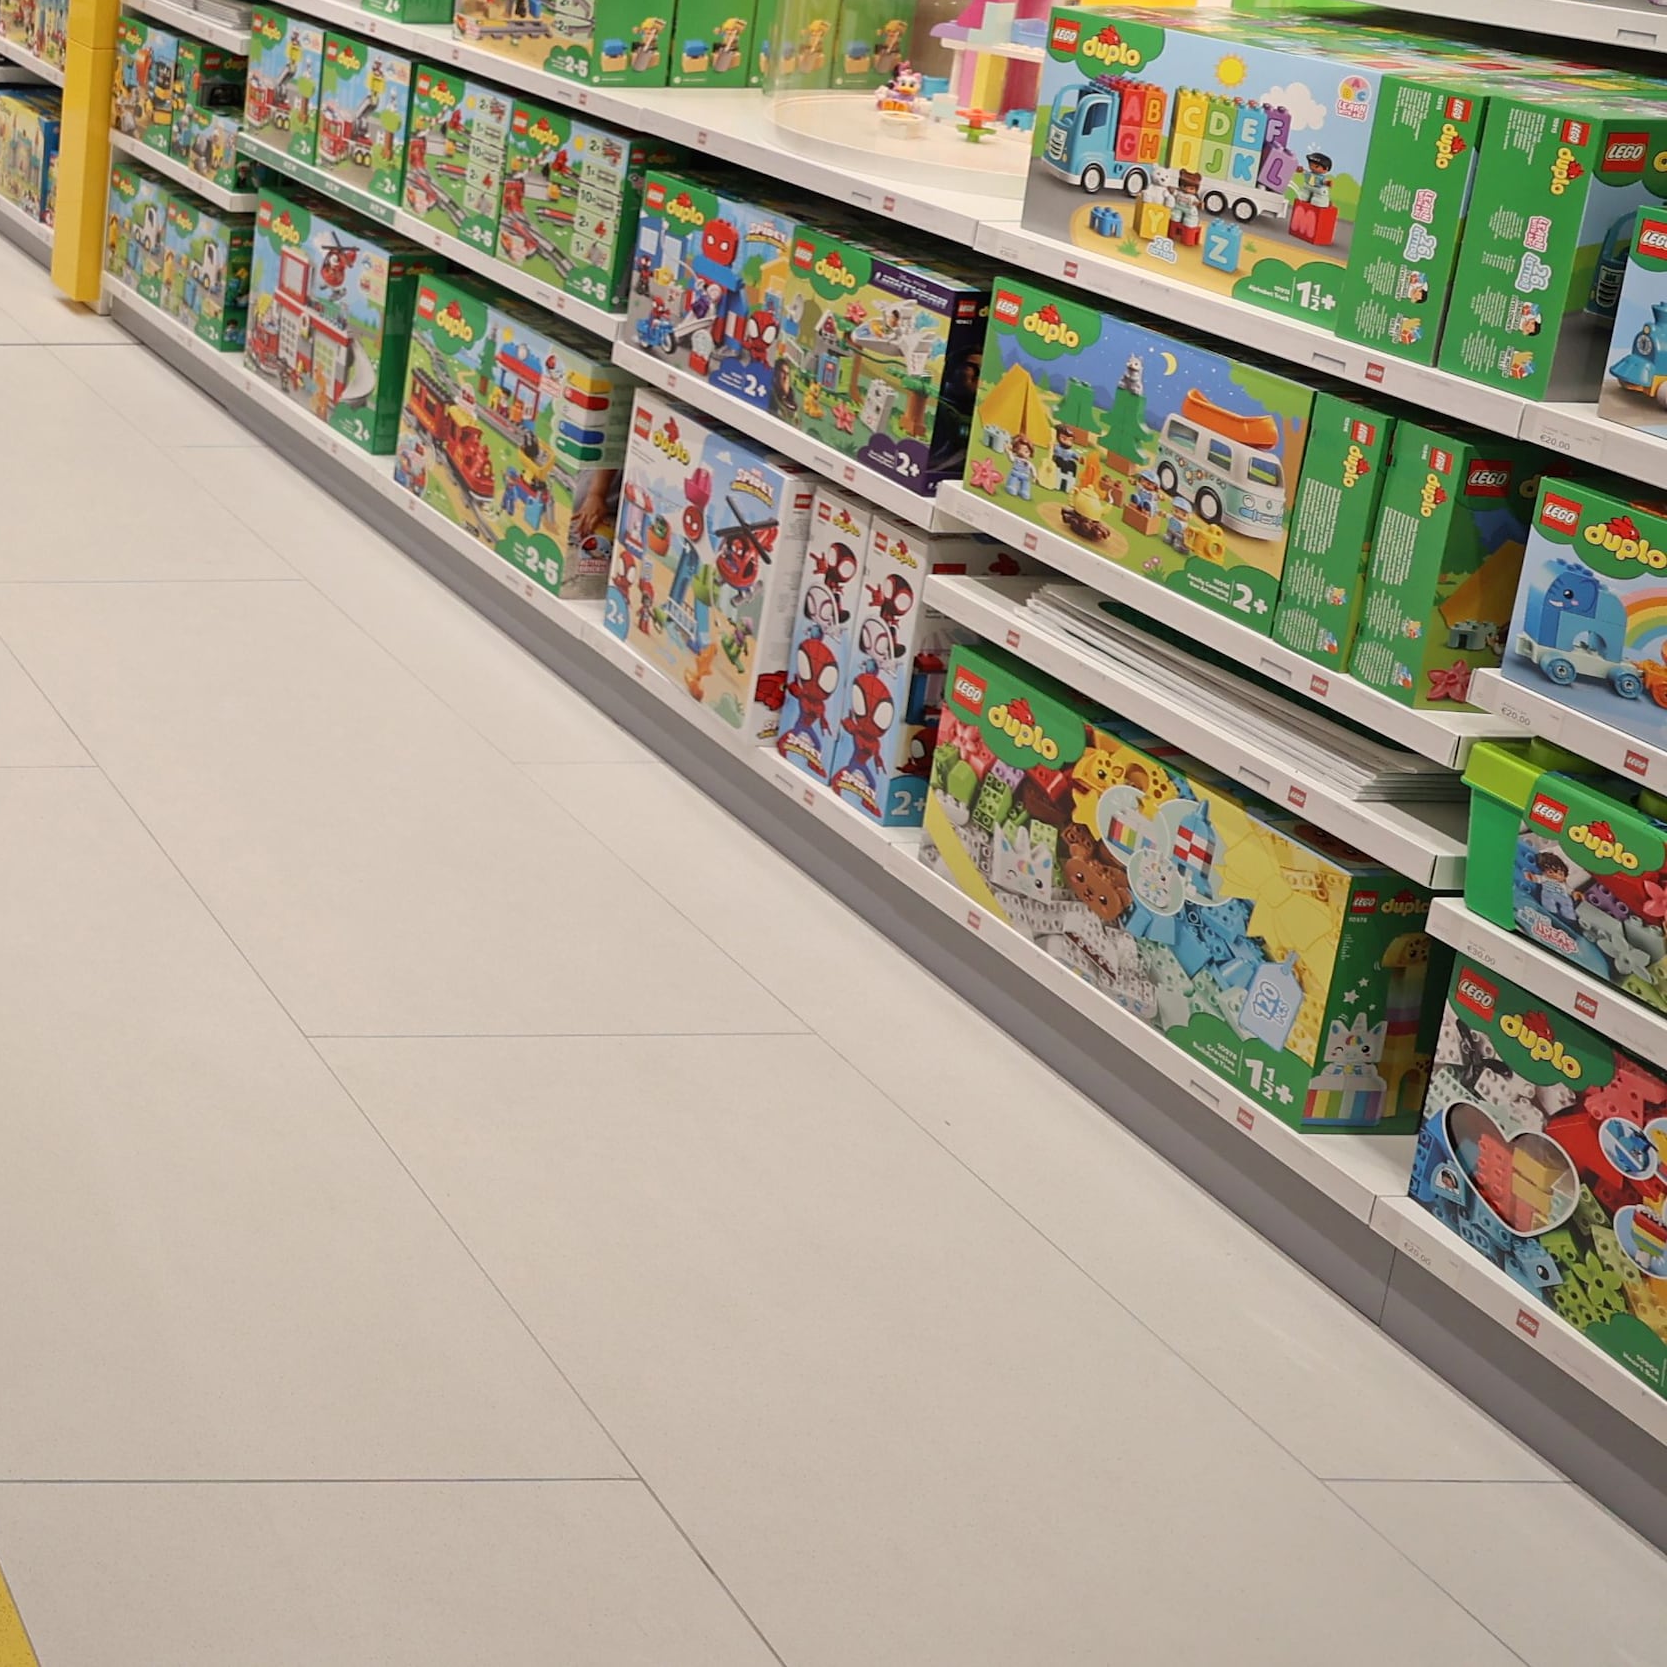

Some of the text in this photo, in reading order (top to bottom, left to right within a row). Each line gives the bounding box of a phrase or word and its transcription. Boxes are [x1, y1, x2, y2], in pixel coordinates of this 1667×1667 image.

[1054, 27, 1143, 67] LEGO duplo
[1550, 147, 1575, 195] duplo
[1605, 142, 1645, 162] LEGO
[1022, 311, 1081, 348] duplo
[1539, 433, 1571, 452] €20.00
[1583, 523, 1667, 568] duplo
[1234, 583, 1269, 614] 2+
[987, 704, 1059, 761] duplo
[1500, 705, 1532, 727] €20.00
[1567, 824, 1640, 870] duplo
[1466, 944, 1497, 966] €30.00
[1457, 979, 1583, 1080] LEGO duplo
